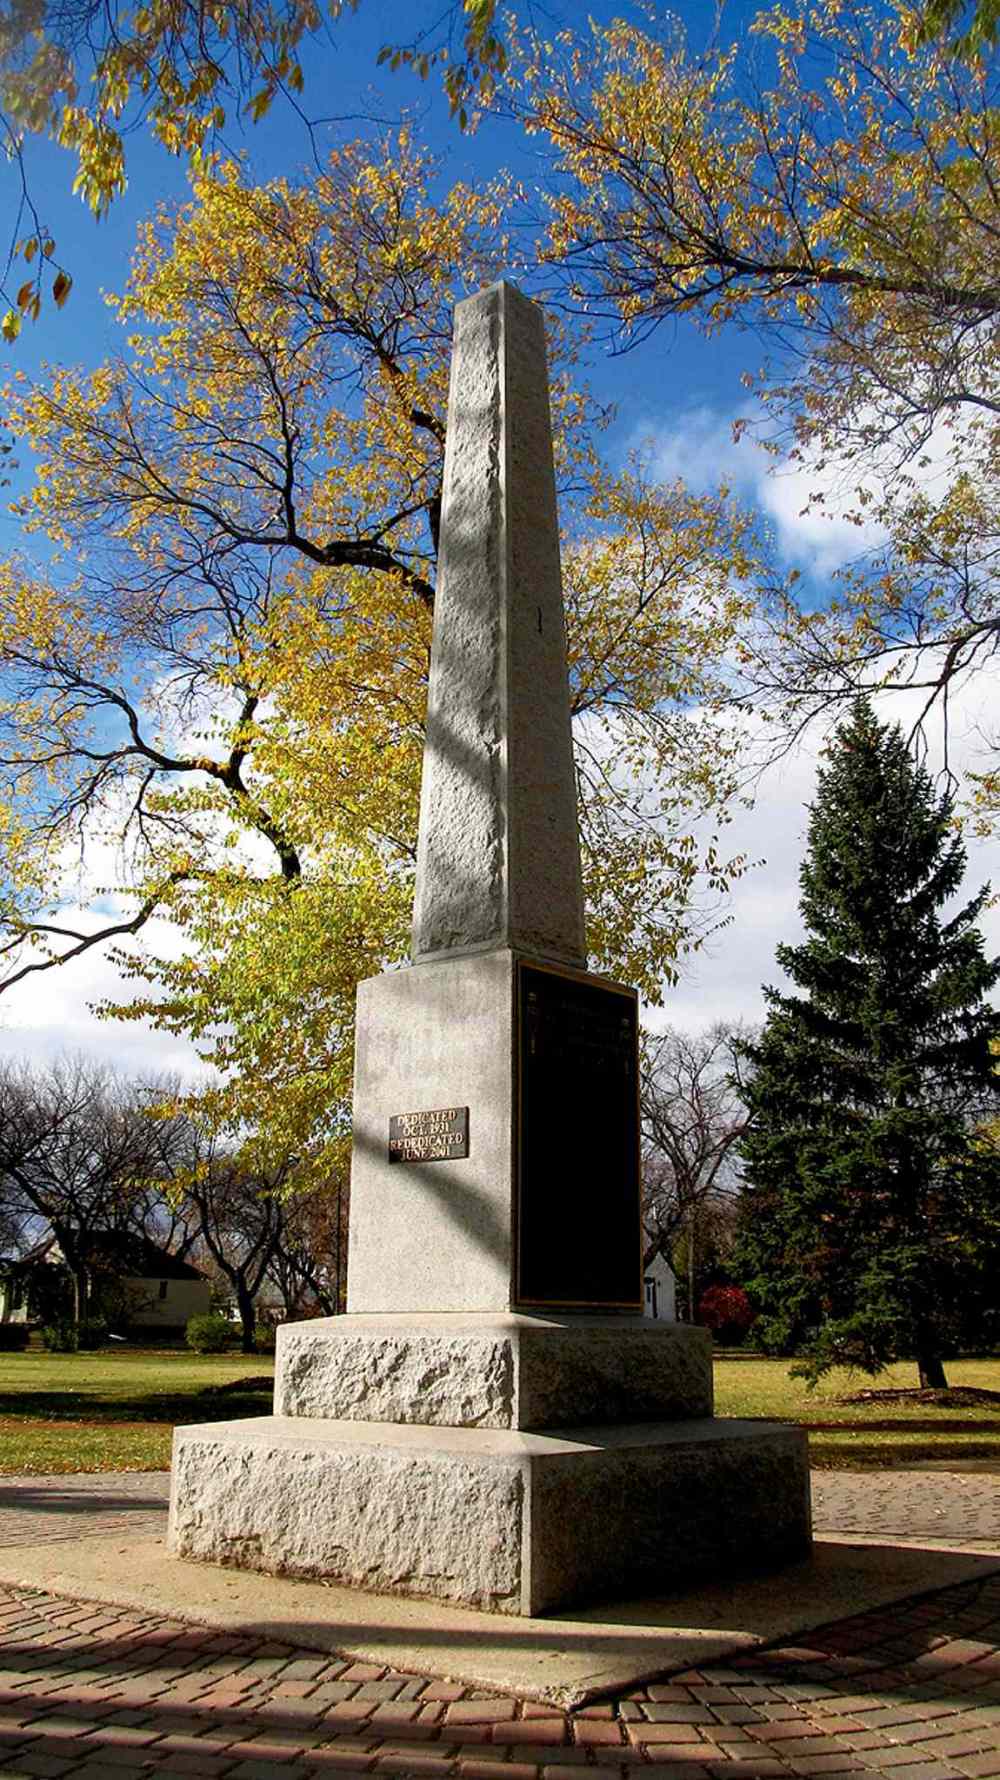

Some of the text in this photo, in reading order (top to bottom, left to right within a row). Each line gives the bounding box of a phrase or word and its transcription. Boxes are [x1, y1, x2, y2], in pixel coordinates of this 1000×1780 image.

[397, 1110, 456, 1126] DEDICATED
[390, 1132, 463, 1151] REDEDICATED
[400, 1147, 427, 1161] JUNE
